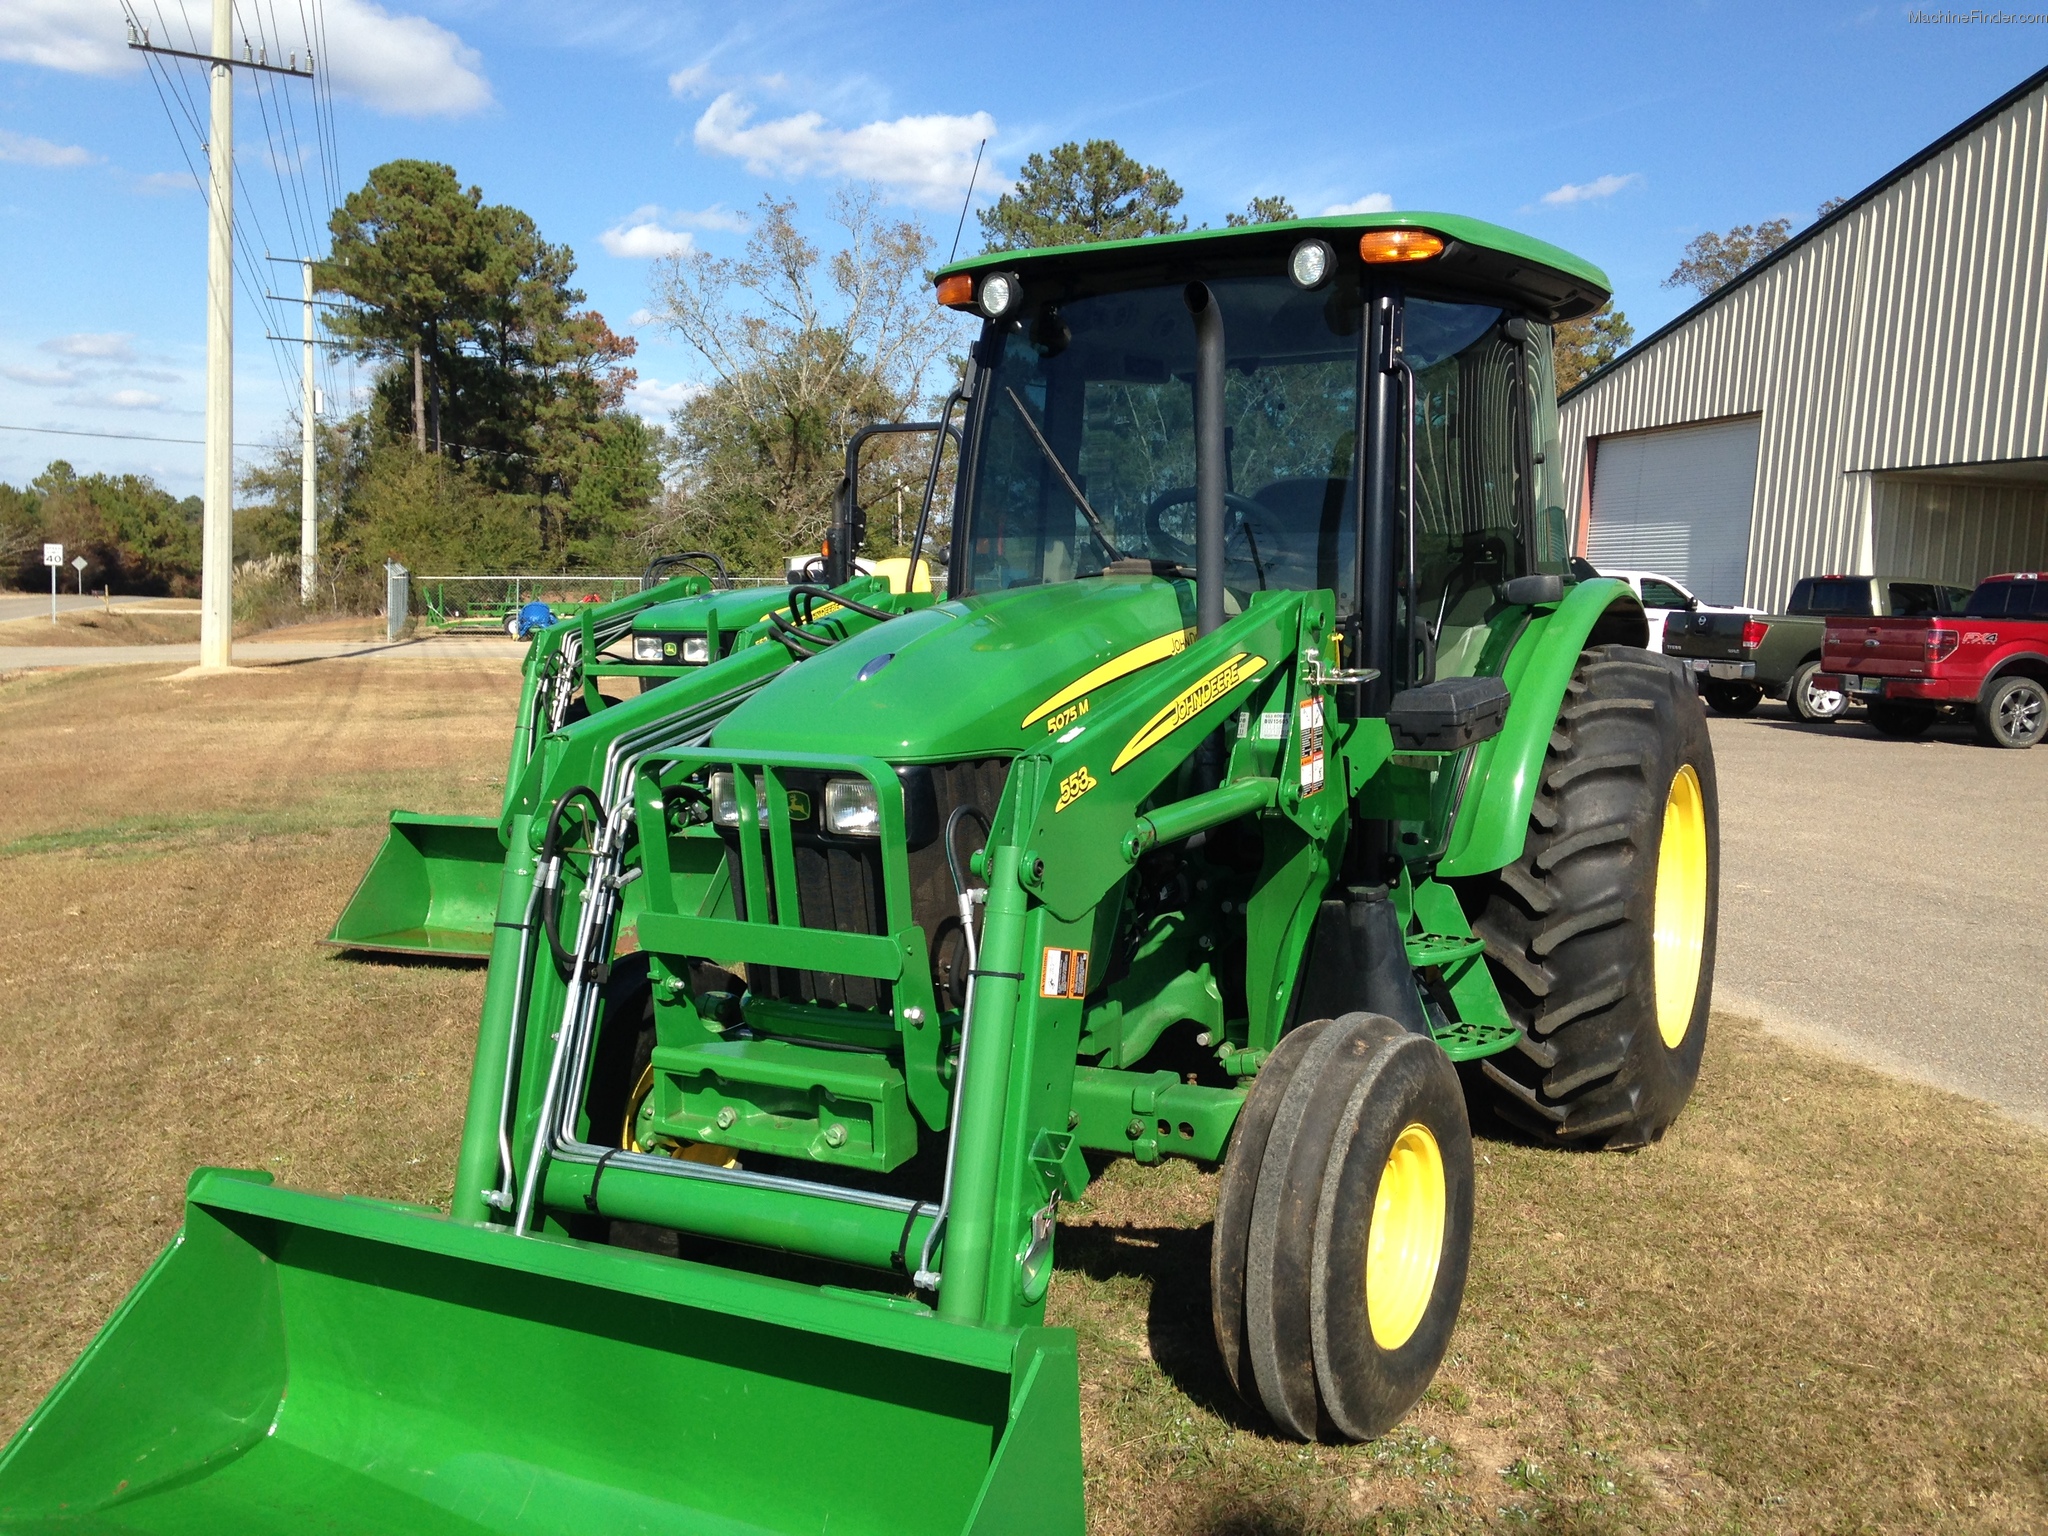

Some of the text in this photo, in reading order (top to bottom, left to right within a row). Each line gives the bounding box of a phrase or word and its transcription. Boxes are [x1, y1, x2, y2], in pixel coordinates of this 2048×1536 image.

[46, 555, 62, 563] 40
[1962, 632, 1998, 643] FX4
[1172, 685, 1203, 726] JOHN
[1202, 663, 1239, 704] DEERE
[1047, 698, 1089, 736] 5075 M
[1060, 766, 1089, 804] 553
